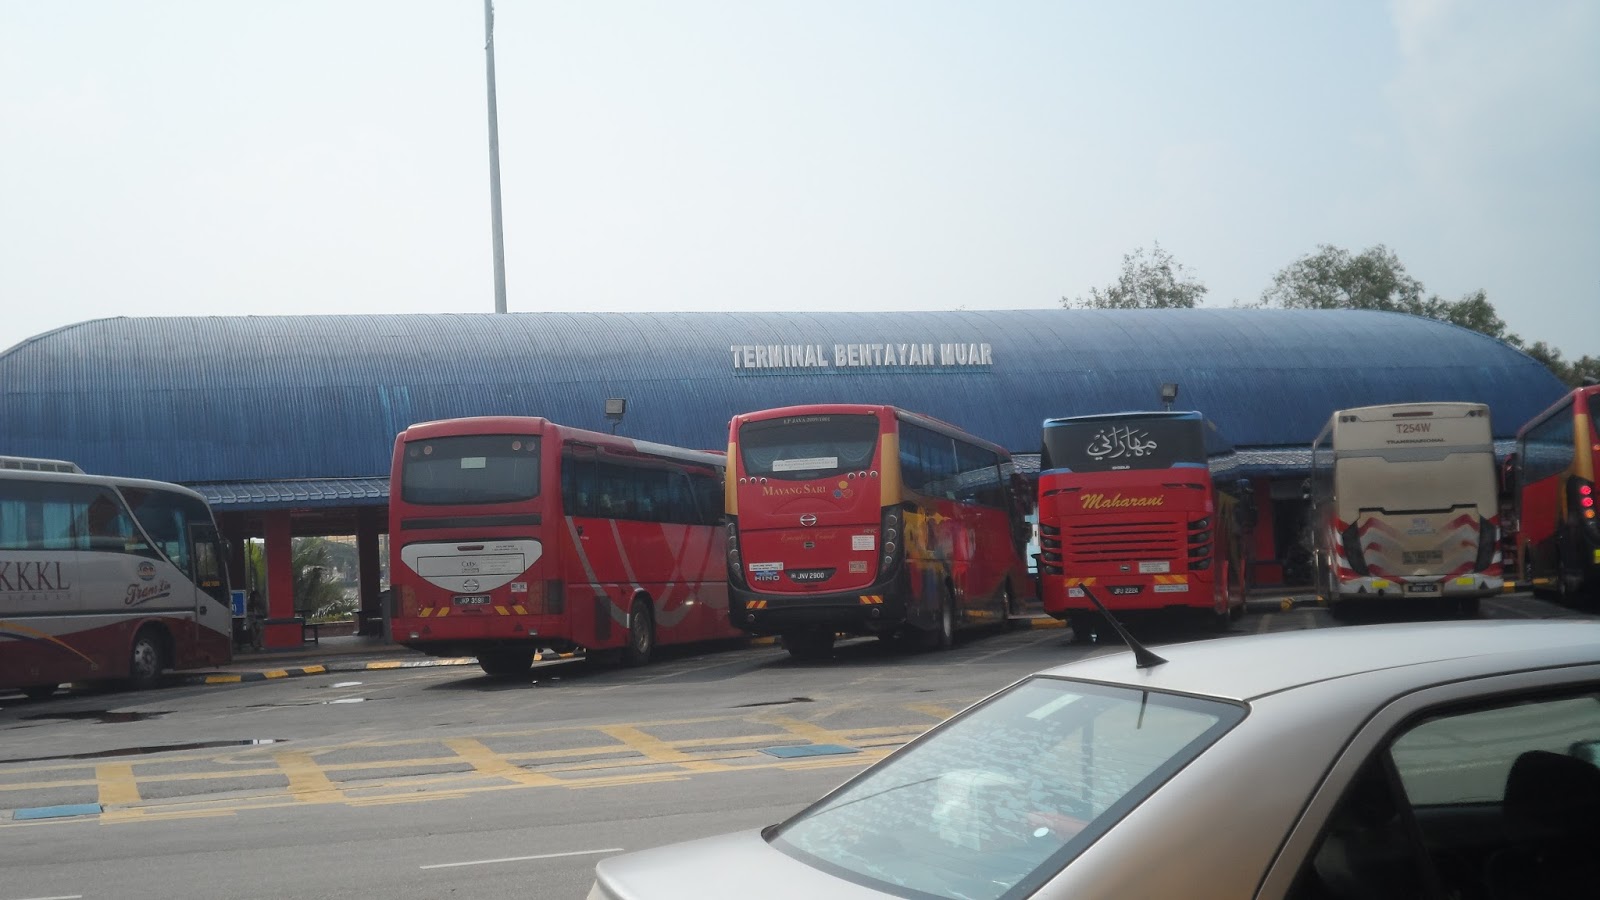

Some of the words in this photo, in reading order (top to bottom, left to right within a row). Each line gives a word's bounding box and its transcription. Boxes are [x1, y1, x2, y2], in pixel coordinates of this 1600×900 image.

[730, 344, 828, 369] TERMINAL
[834, 343, 934, 367] BENTAYAN
[941, 343, 993, 366] MUAR
[1396, 422, 1431, 433] T254W
[762, 486, 802, 496] MAYANG
[803, 484, 826, 494] SARI
[1080, 493, 1165, 510] Maharani
[125, 584, 158, 605] Trans
